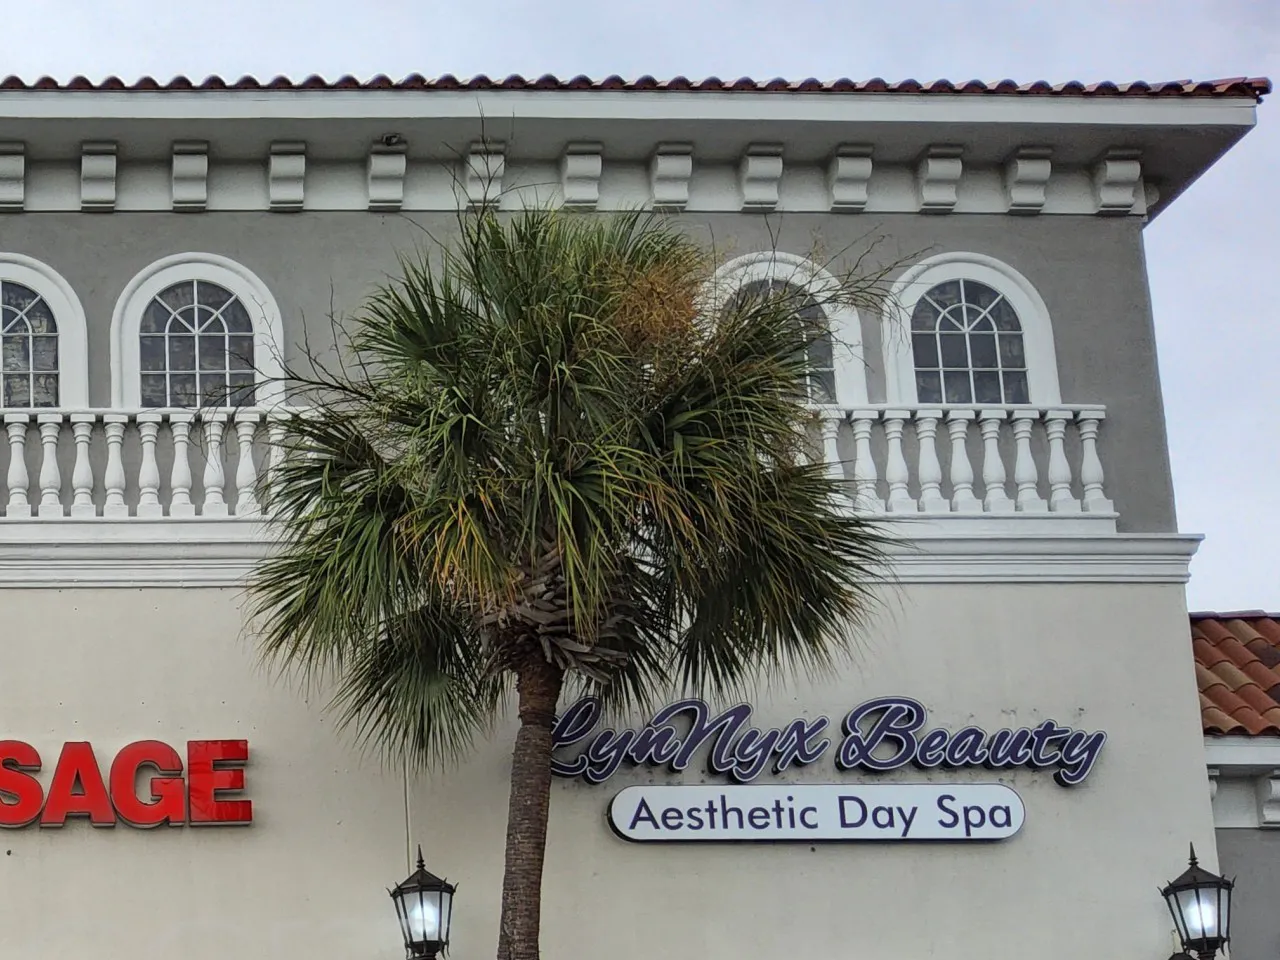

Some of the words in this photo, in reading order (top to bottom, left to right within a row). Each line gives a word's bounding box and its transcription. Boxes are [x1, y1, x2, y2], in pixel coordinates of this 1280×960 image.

[834, 697, 1108, 787] Beauty
[629, 796, 819, 830] Aesthetic
[838, 796, 919, 838] Day
[937, 794, 1013, 837] Spa
